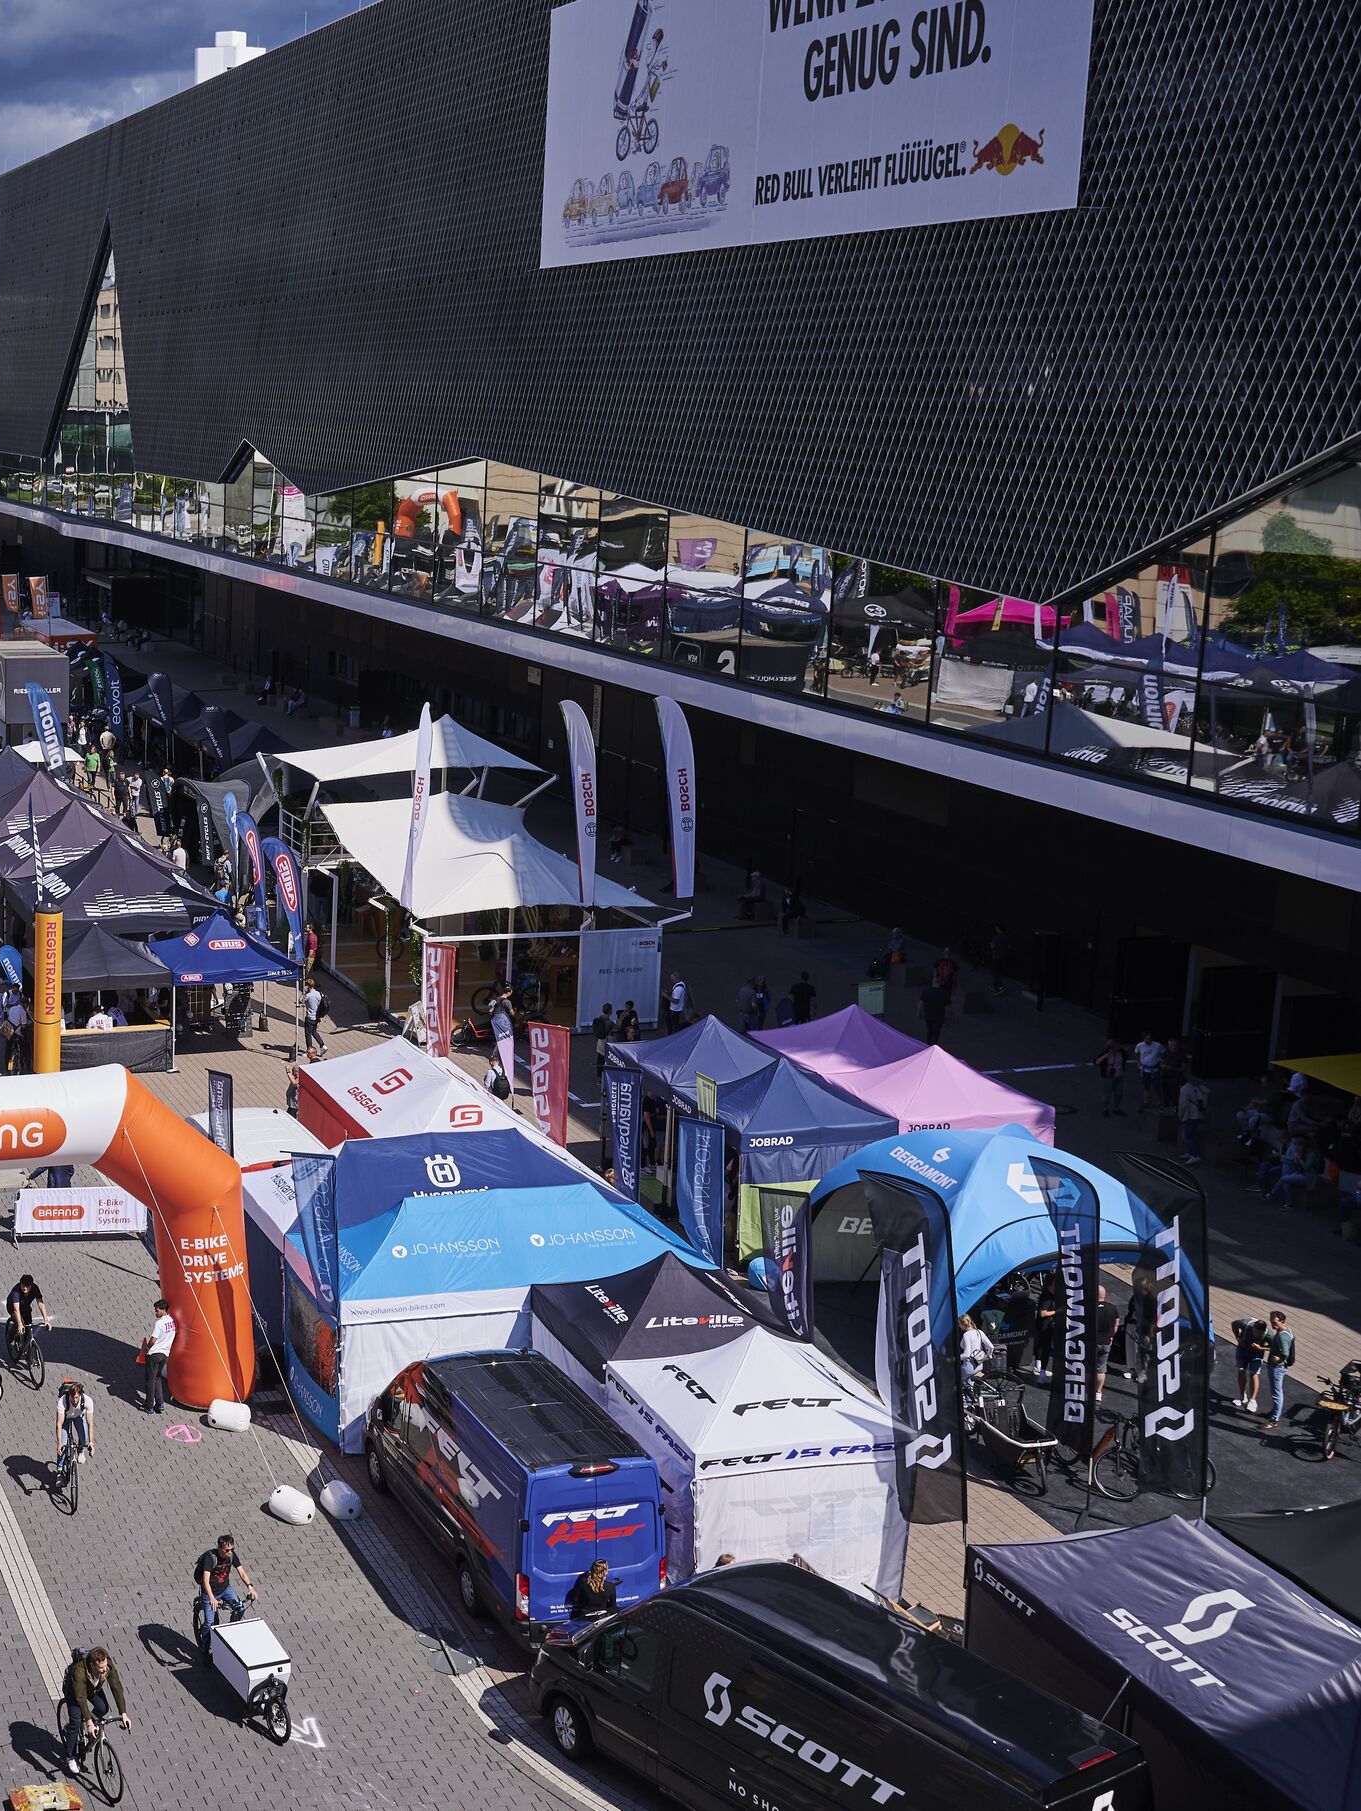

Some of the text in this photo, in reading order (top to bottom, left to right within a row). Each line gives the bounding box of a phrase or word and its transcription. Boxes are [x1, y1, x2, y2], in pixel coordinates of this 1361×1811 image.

[803, 27, 901, 101] GENUG
[910, 2, 991, 79] SIND.
[755, 174, 779, 205] RED
[782, 166, 813, 201] BULL
[818, 157, 882, 197] VERLEIHT
[113, 680, 121, 725] eovolt
[0, 834, 34, 860] pinion
[213, 940, 241, 949] ABUS
[46, 921, 57, 1016] REGISTRATION
[347, 1085, 383, 1116] GASGAS
[671, 1094, 692, 1114] JOBRAD
[907, 1122, 951, 1133] JOBRAD
[749, 1136, 794, 1148] JOBRAD
[890, 1146, 958, 1190] BERGAMONT
[38, 1207, 80, 1218] BAFANG
[98, 1199, 124, 1208] E-Bike
[98, 1208, 120, 1216] Drive
[98, 1216, 131, 1225] Systems
[180, 1235, 228, 1251] E-BIKE
[411, 1237, 500, 1255] JOHANSSON
[548, 1227, 635, 1246] JOHANSSON
[182, 1252, 227, 1268] DRIVE
[452, 1251, 464, 1259] THE
[184, 1262, 244, 1284] SYSTEMS
[351, 1300, 446, 1316] www.johansson-bikes.com
[585, 1284, 629, 1325] Liteville
[645, 1314, 744, 1328] Liteville
[663, 1364, 716, 1405] FELT
[732, 1397, 842, 1416] FELT
[607, 1374, 693, 1462] FELT IS FAST
[420, 1413, 502, 1500] FELT
[700, 1448, 822, 1471] FELT IS
[542, 1504, 640, 1527] FELT
[546, 1524, 646, 1547] FAST
[982, 1571, 1037, 1618] SCOTT
[1103, 1606, 1227, 1689] SCOTT
[735, 1704, 905, 1804] SCOTT
[728, 1778, 748, 1796] NO
